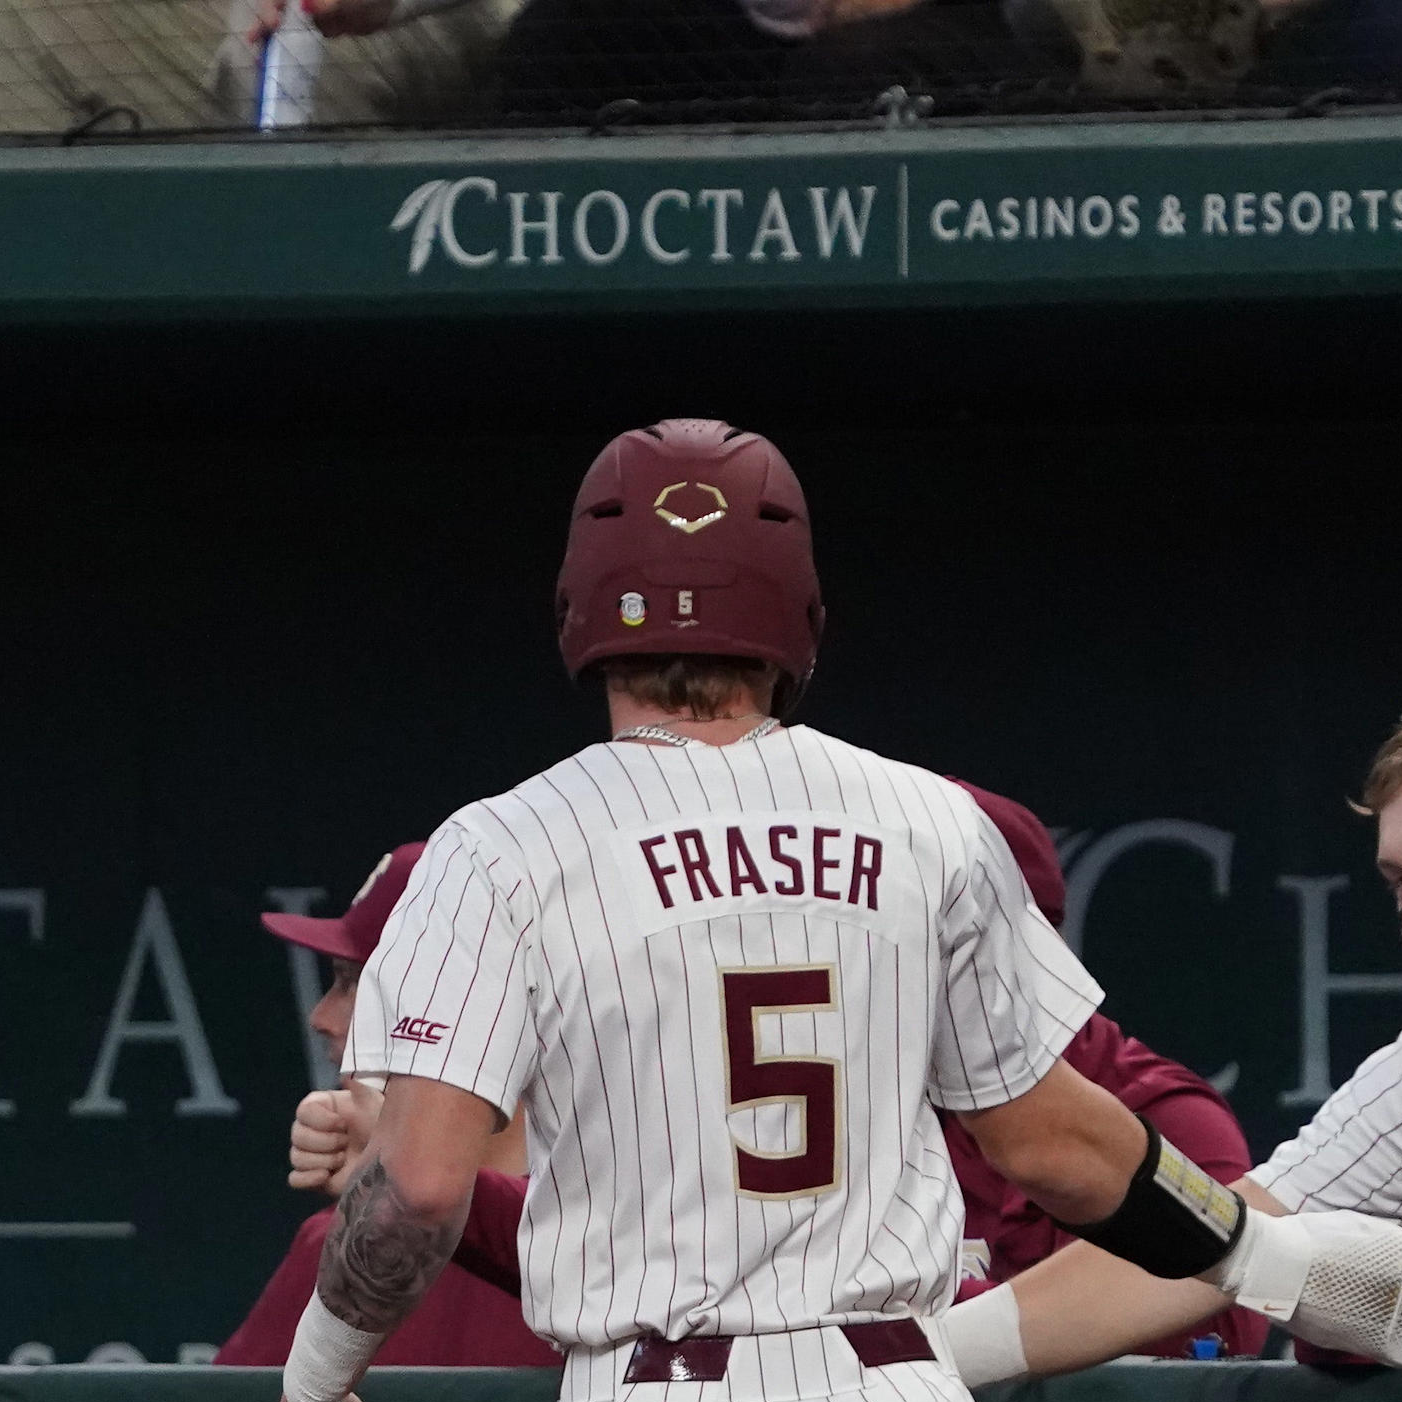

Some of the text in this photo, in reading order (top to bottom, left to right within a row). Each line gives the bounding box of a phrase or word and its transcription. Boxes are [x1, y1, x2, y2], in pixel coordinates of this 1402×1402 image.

[441, 178, 876, 268] CHOCTAW
[932, 195, 1139, 241] CASINOS
[1158, 195, 1185, 235] &
[678, 590, 693, 615] 5
[639, 824, 884, 912] FRASER
[391, 1016, 450, 1044] ACC
[719, 962, 844, 1200] 5
